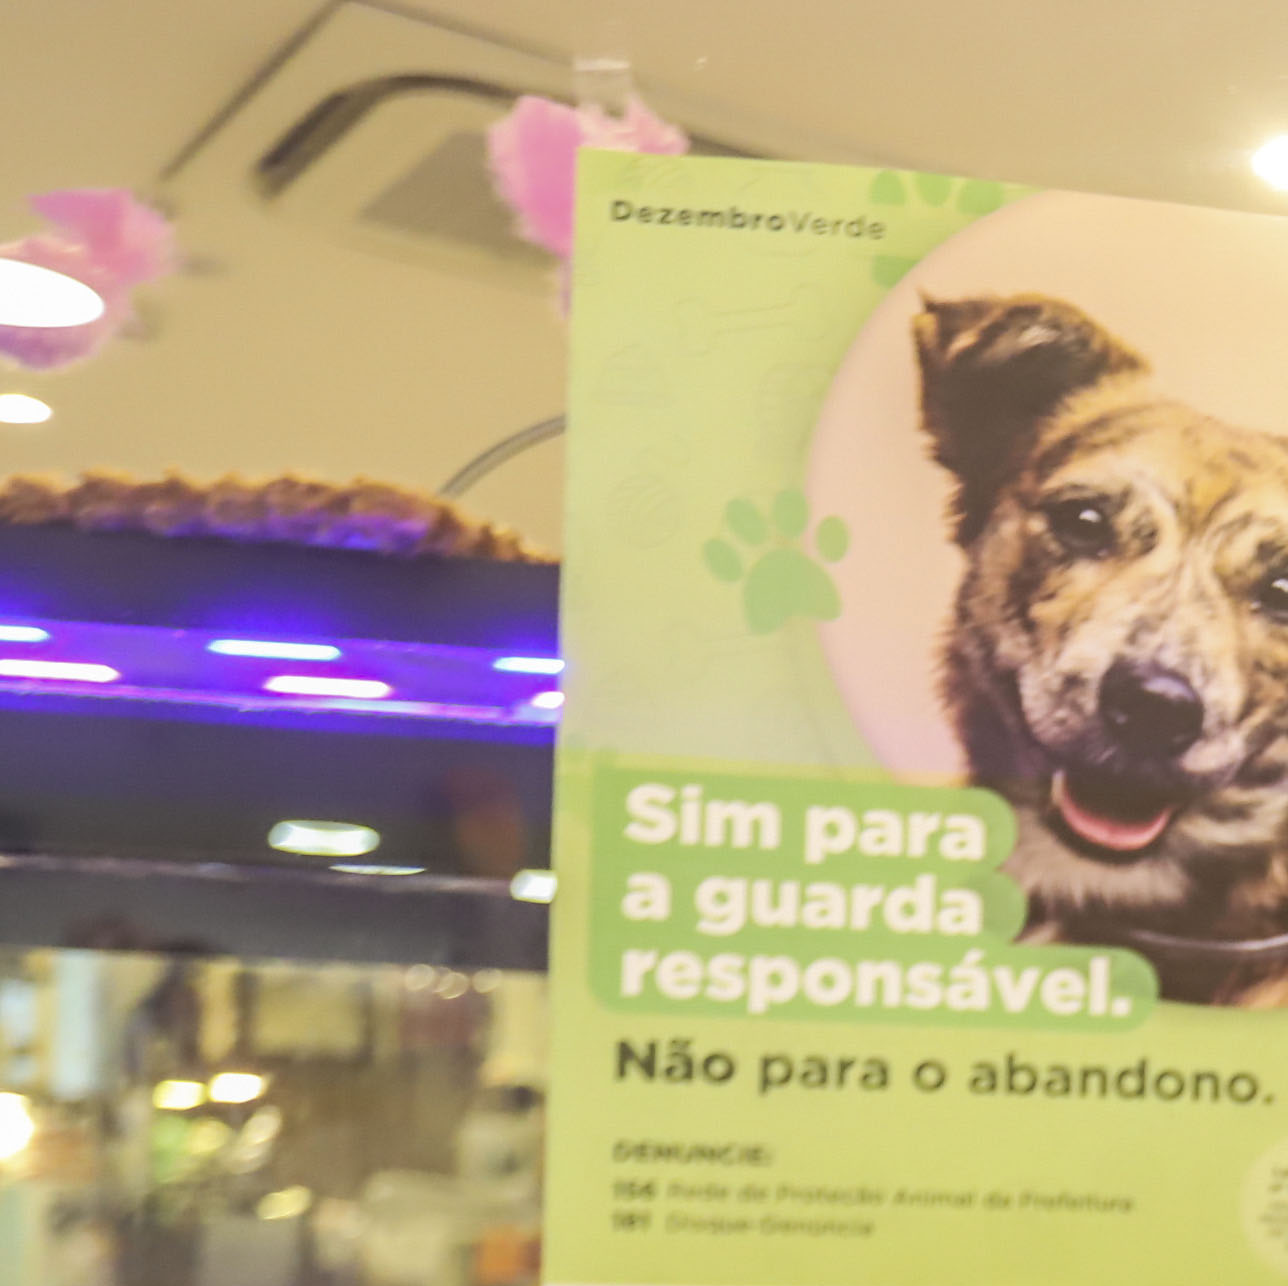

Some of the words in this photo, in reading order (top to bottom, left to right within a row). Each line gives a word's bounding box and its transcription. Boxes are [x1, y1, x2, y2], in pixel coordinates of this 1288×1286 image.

[609, 199, 886, 240] DezembroVerde
[624, 783, 780, 850] Sim
[805, 804, 987, 864] para
[621, 872, 672, 921] a
[694, 872, 983, 937] guarda
[620, 948, 1132, 1017] responsável.
[615, 1039, 736, 1083] Não
[759, 1053, 890, 1094] para
[912, 1058, 949, 1093] o
[967, 1054, 1275, 1106] abandono.
